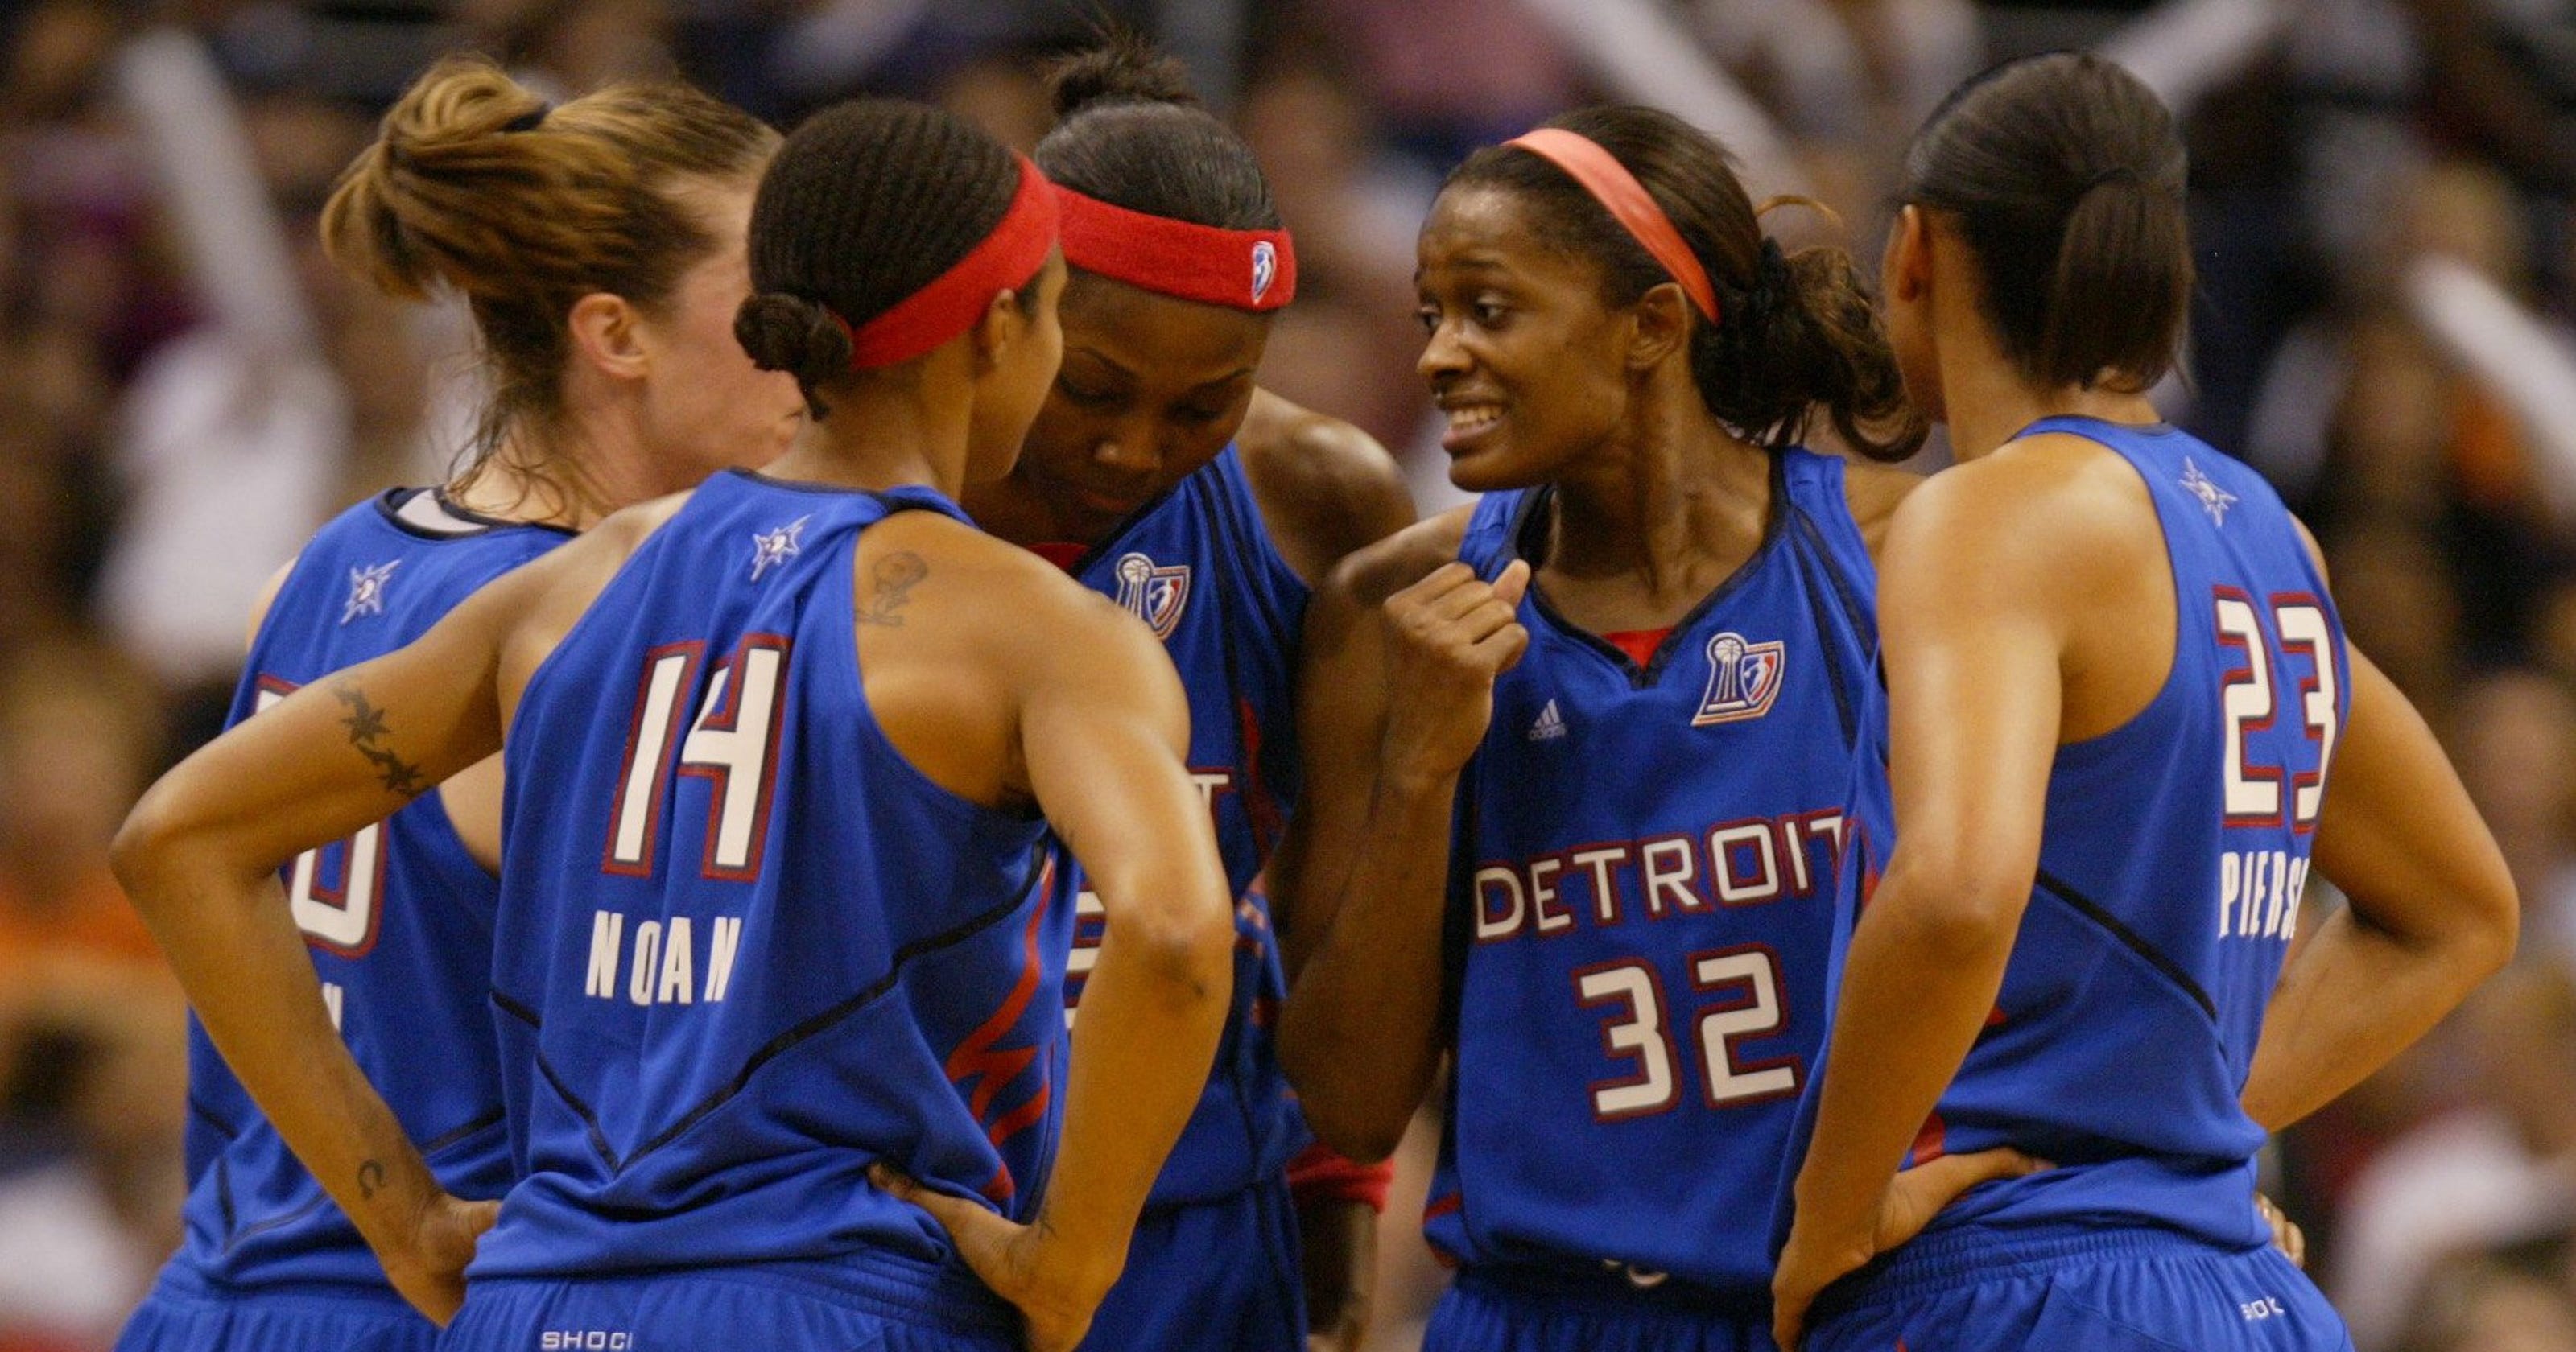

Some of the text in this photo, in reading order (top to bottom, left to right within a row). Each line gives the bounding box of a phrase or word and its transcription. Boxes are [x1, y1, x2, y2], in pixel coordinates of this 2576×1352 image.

[602, 633, 794, 883] 14
[2213, 584, 2338, 835] 23
[1571, 942, 1802, 1123] 32
